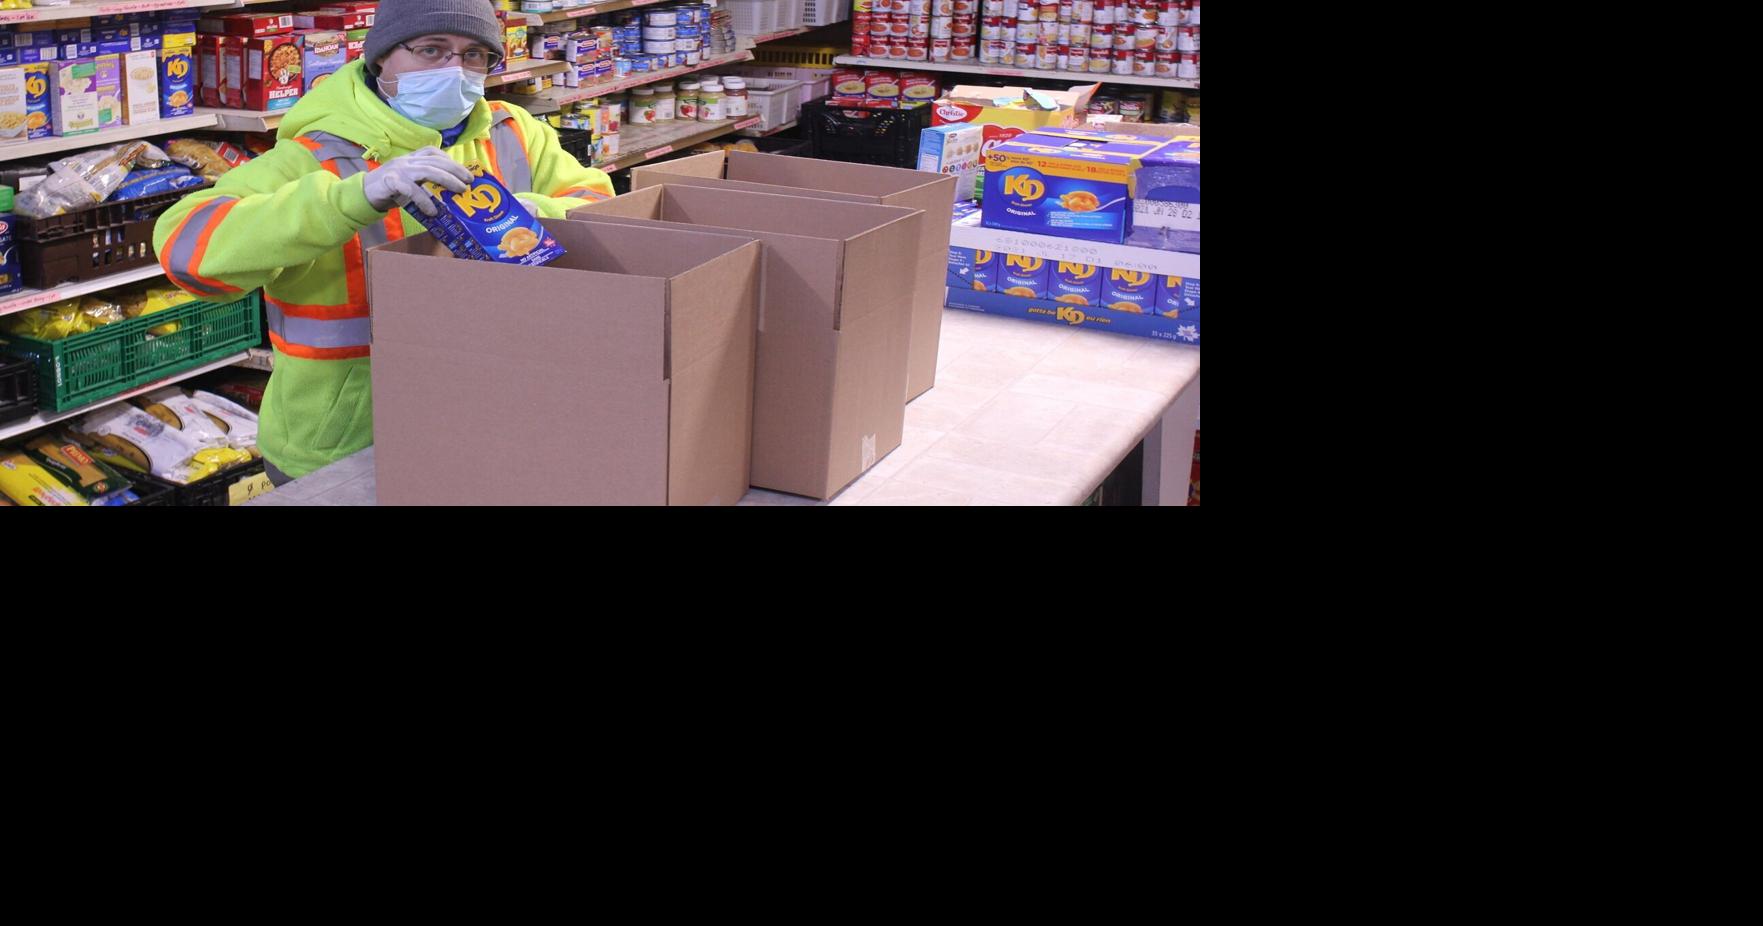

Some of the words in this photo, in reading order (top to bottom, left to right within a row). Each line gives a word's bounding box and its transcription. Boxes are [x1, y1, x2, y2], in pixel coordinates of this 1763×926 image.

[314, 43, 339, 54] IDAHOAN
[167, 57, 189, 78] KD
[268, 87, 298, 99] HELPER
[938, 107, 966, 118] Christie
[1003, 174, 1046, 202] KD
[451, 183, 502, 218] KD
[1006, 207, 1037, 216] ORIGINAL
[485, 215, 519, 234] ORIGINAL
[1006, 253, 1043, 272] KD
[1058, 260, 1096, 279] KD
[1006, 276, 1038, 286] ORIGINAL
[1111, 267, 1151, 286] KD
[1058, 283, 1091, 293] ORIGINAL
[1111, 291, 1144, 301] ORIGINAL
[1056, 306, 1086, 325] KD
